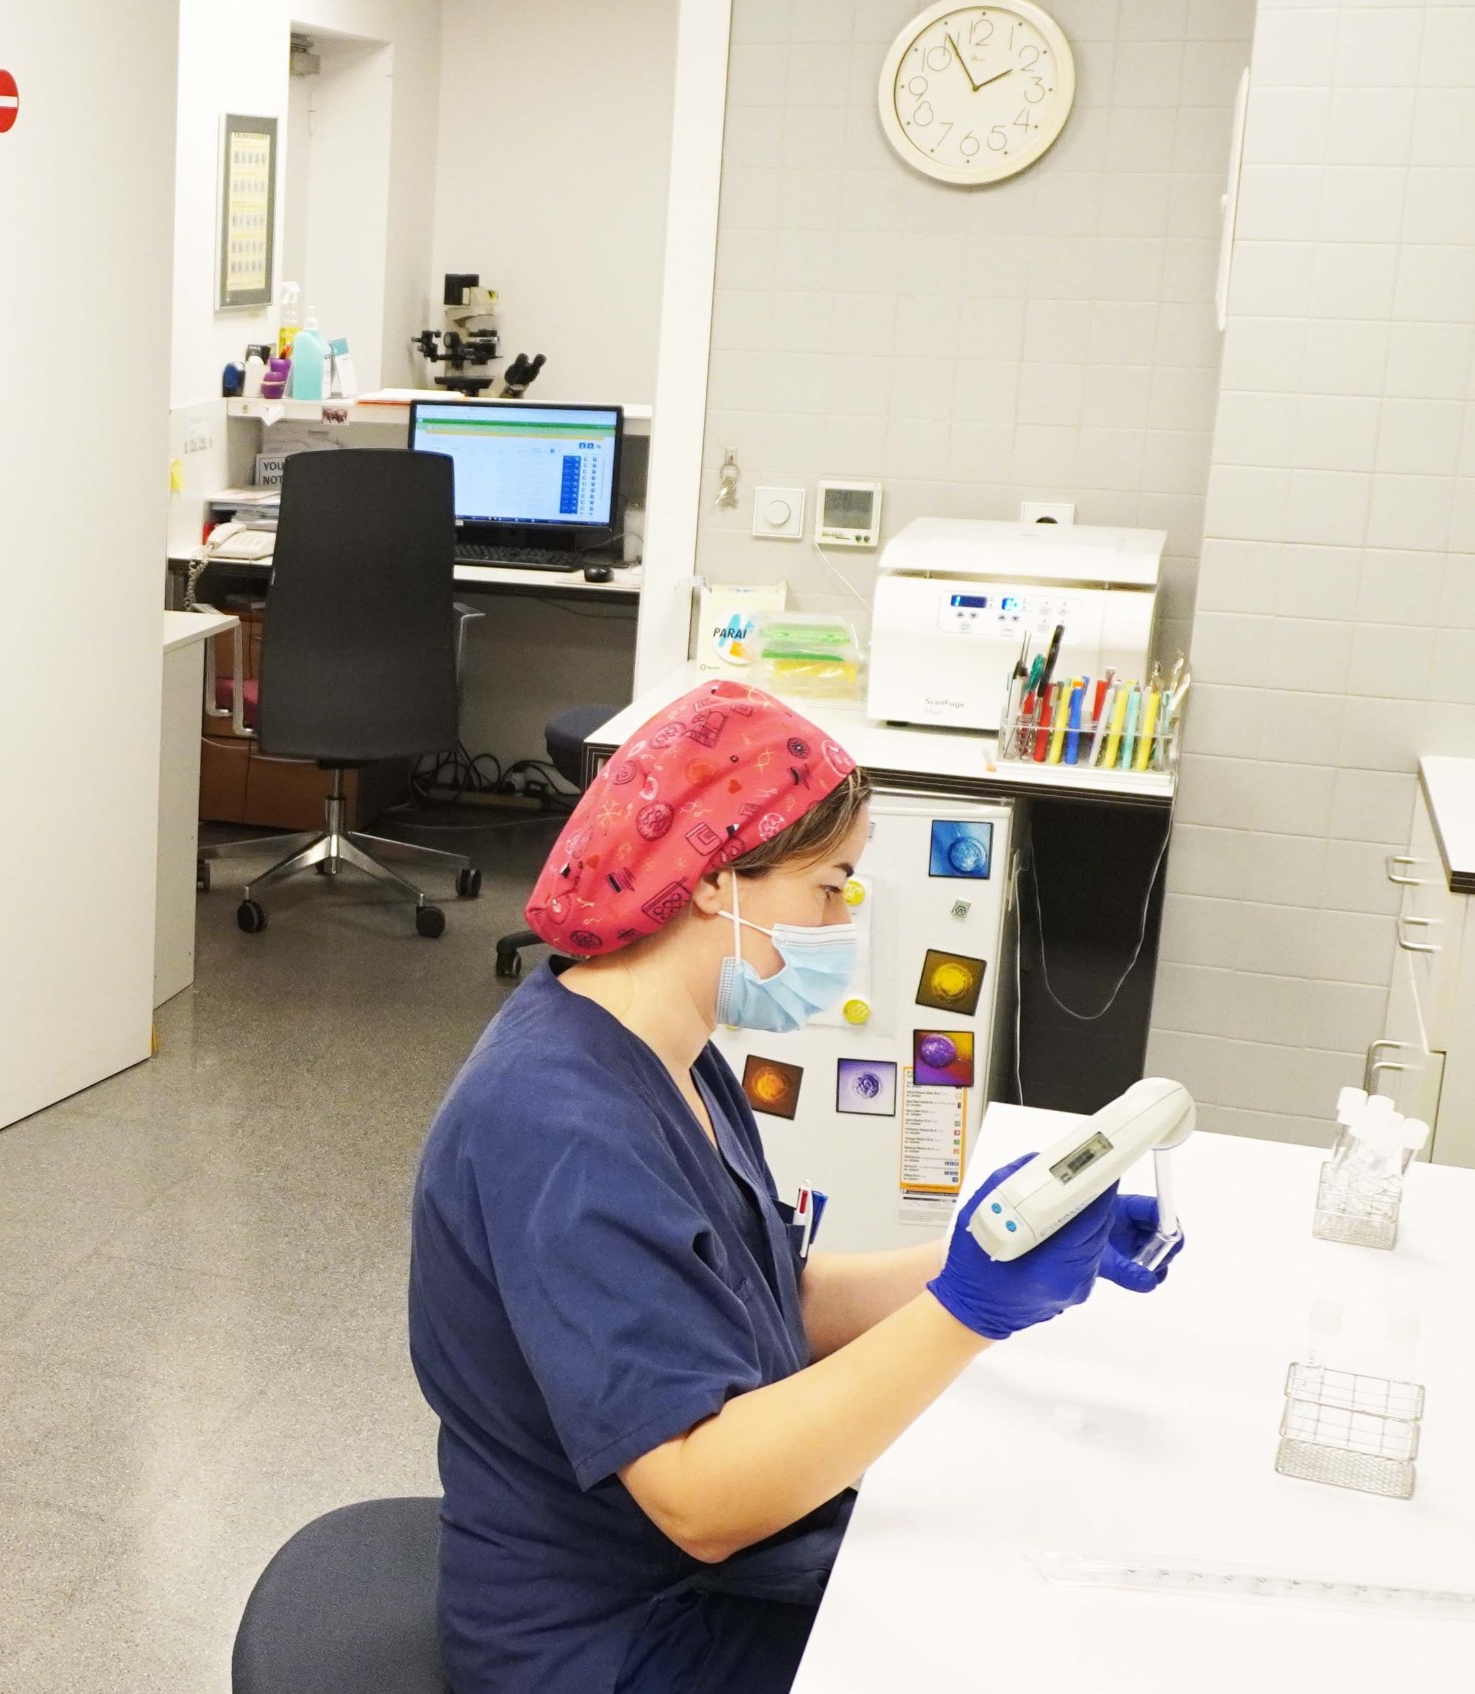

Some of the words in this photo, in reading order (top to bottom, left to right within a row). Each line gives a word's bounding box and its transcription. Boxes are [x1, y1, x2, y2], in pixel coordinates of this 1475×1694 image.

[943, 31, 961, 56] 11
[969, 19, 994, 46] 12
[1009, 26, 1015, 51] 1
[921, 46, 952, 72] 10
[1018, 45, 1040, 72] 2
[908, 76, 928, 102] 9
[1024, 77, 1045, 104] 3
[913, 101, 934, 127] 8
[1012, 108, 1032, 134] 4
[937, 122, 955, 147] 7
[960, 130, 980, 156] 6
[987, 126, 1008, 151] 5
